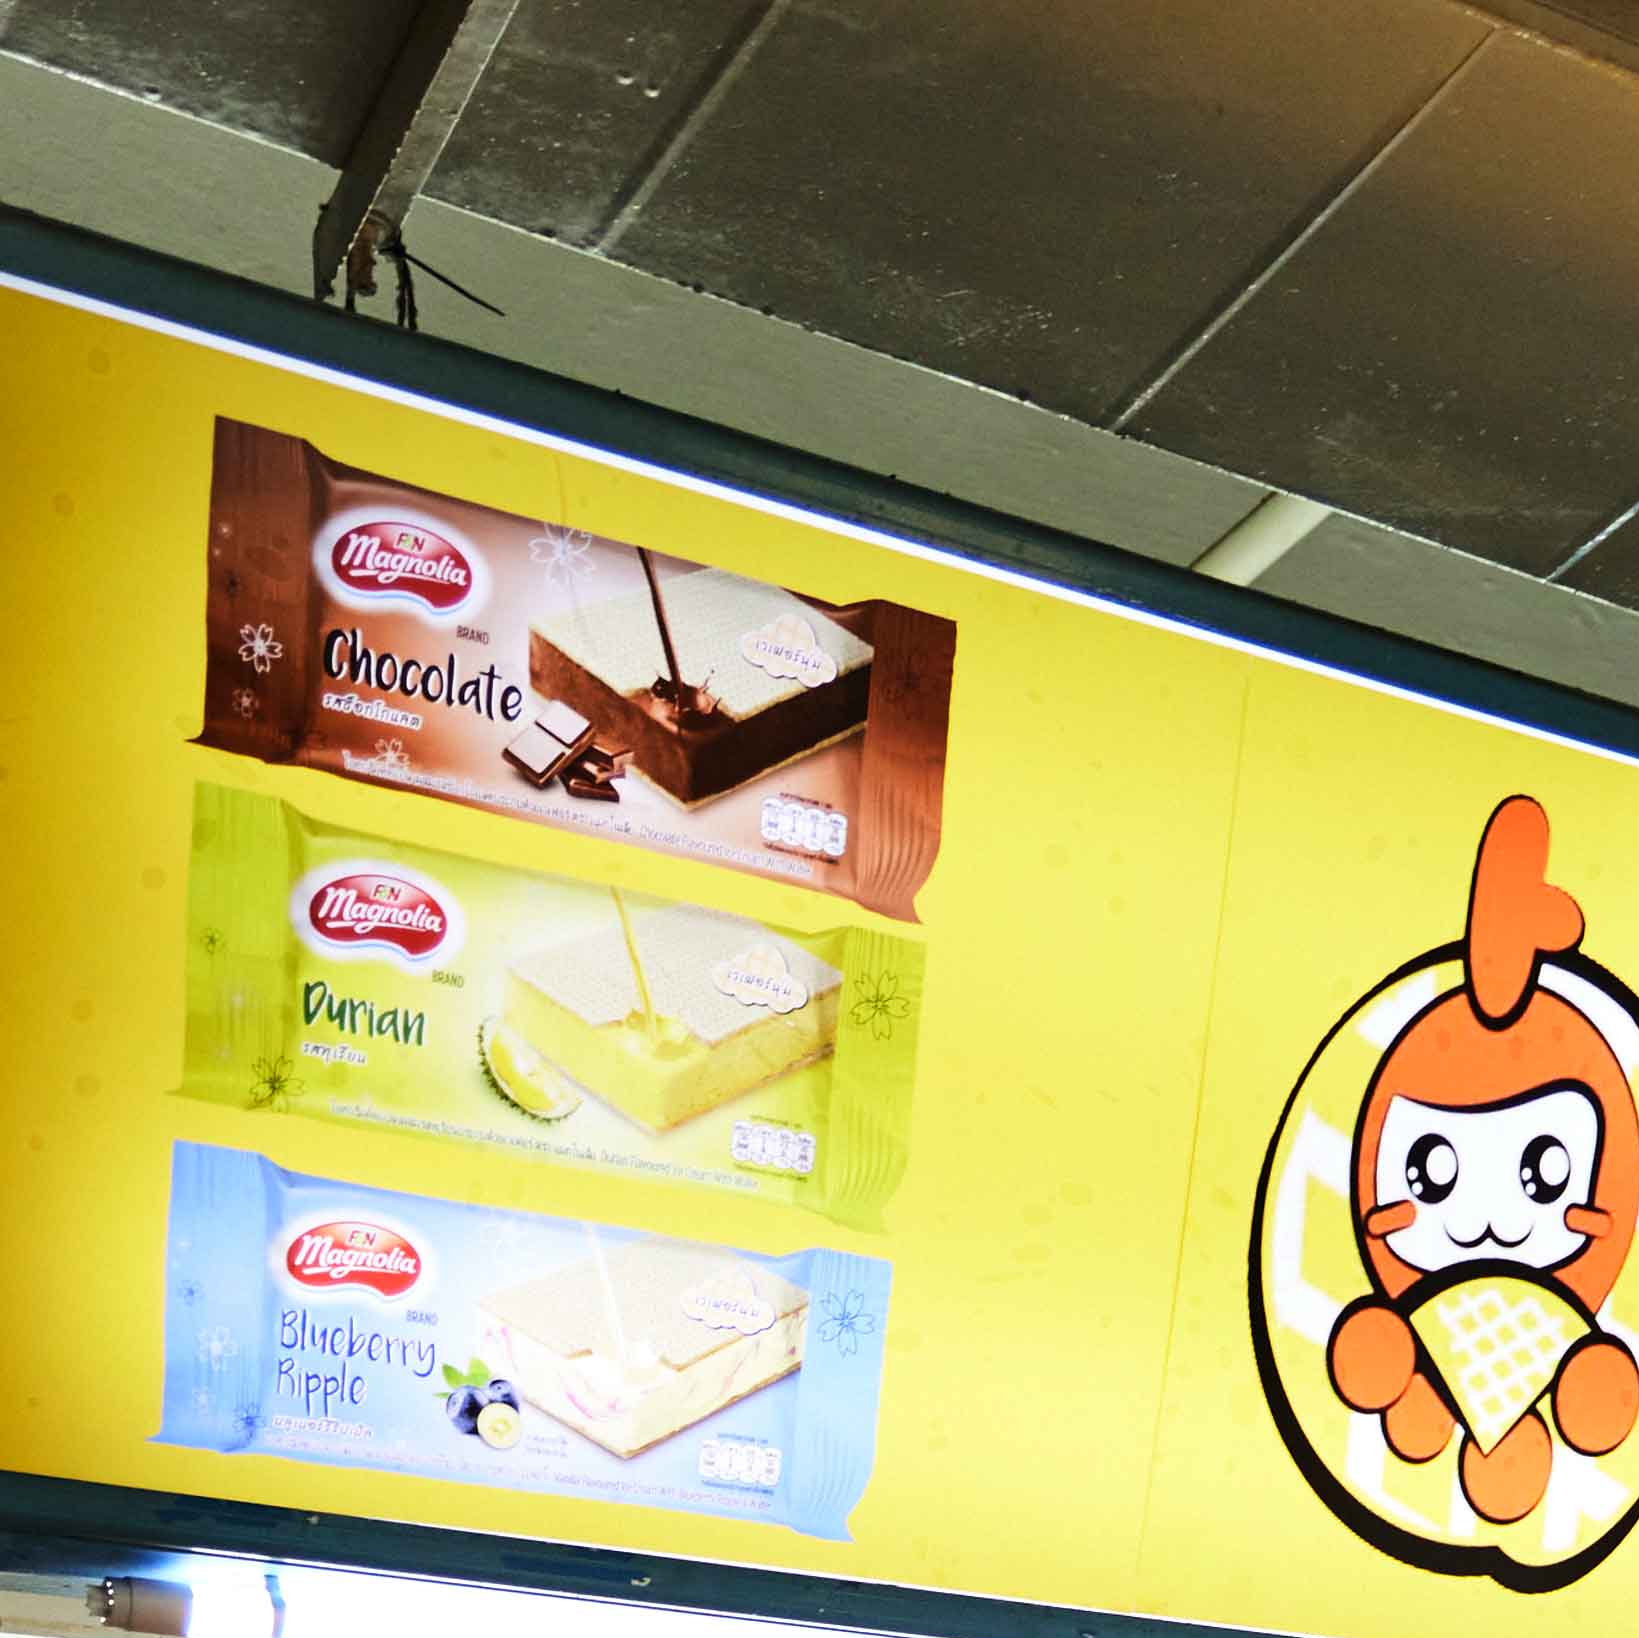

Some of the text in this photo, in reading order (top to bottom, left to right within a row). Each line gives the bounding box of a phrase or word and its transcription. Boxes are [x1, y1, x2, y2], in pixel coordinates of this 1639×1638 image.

[340, 533, 468, 585] Magnolia
[456, 626, 490, 645] BRAND
[323, 627, 523, 721] Chocolate
[318, 887, 442, 933] Magnolia
[431, 969, 464, 988] BRAND
[303, 980, 425, 1046] Durian
[294, 1234, 417, 1279] Magnolia
[279, 1308, 436, 1377] Blueberry
[405, 1310, 439, 1326] BRAND
[277, 1357, 366, 1417] Ripple
